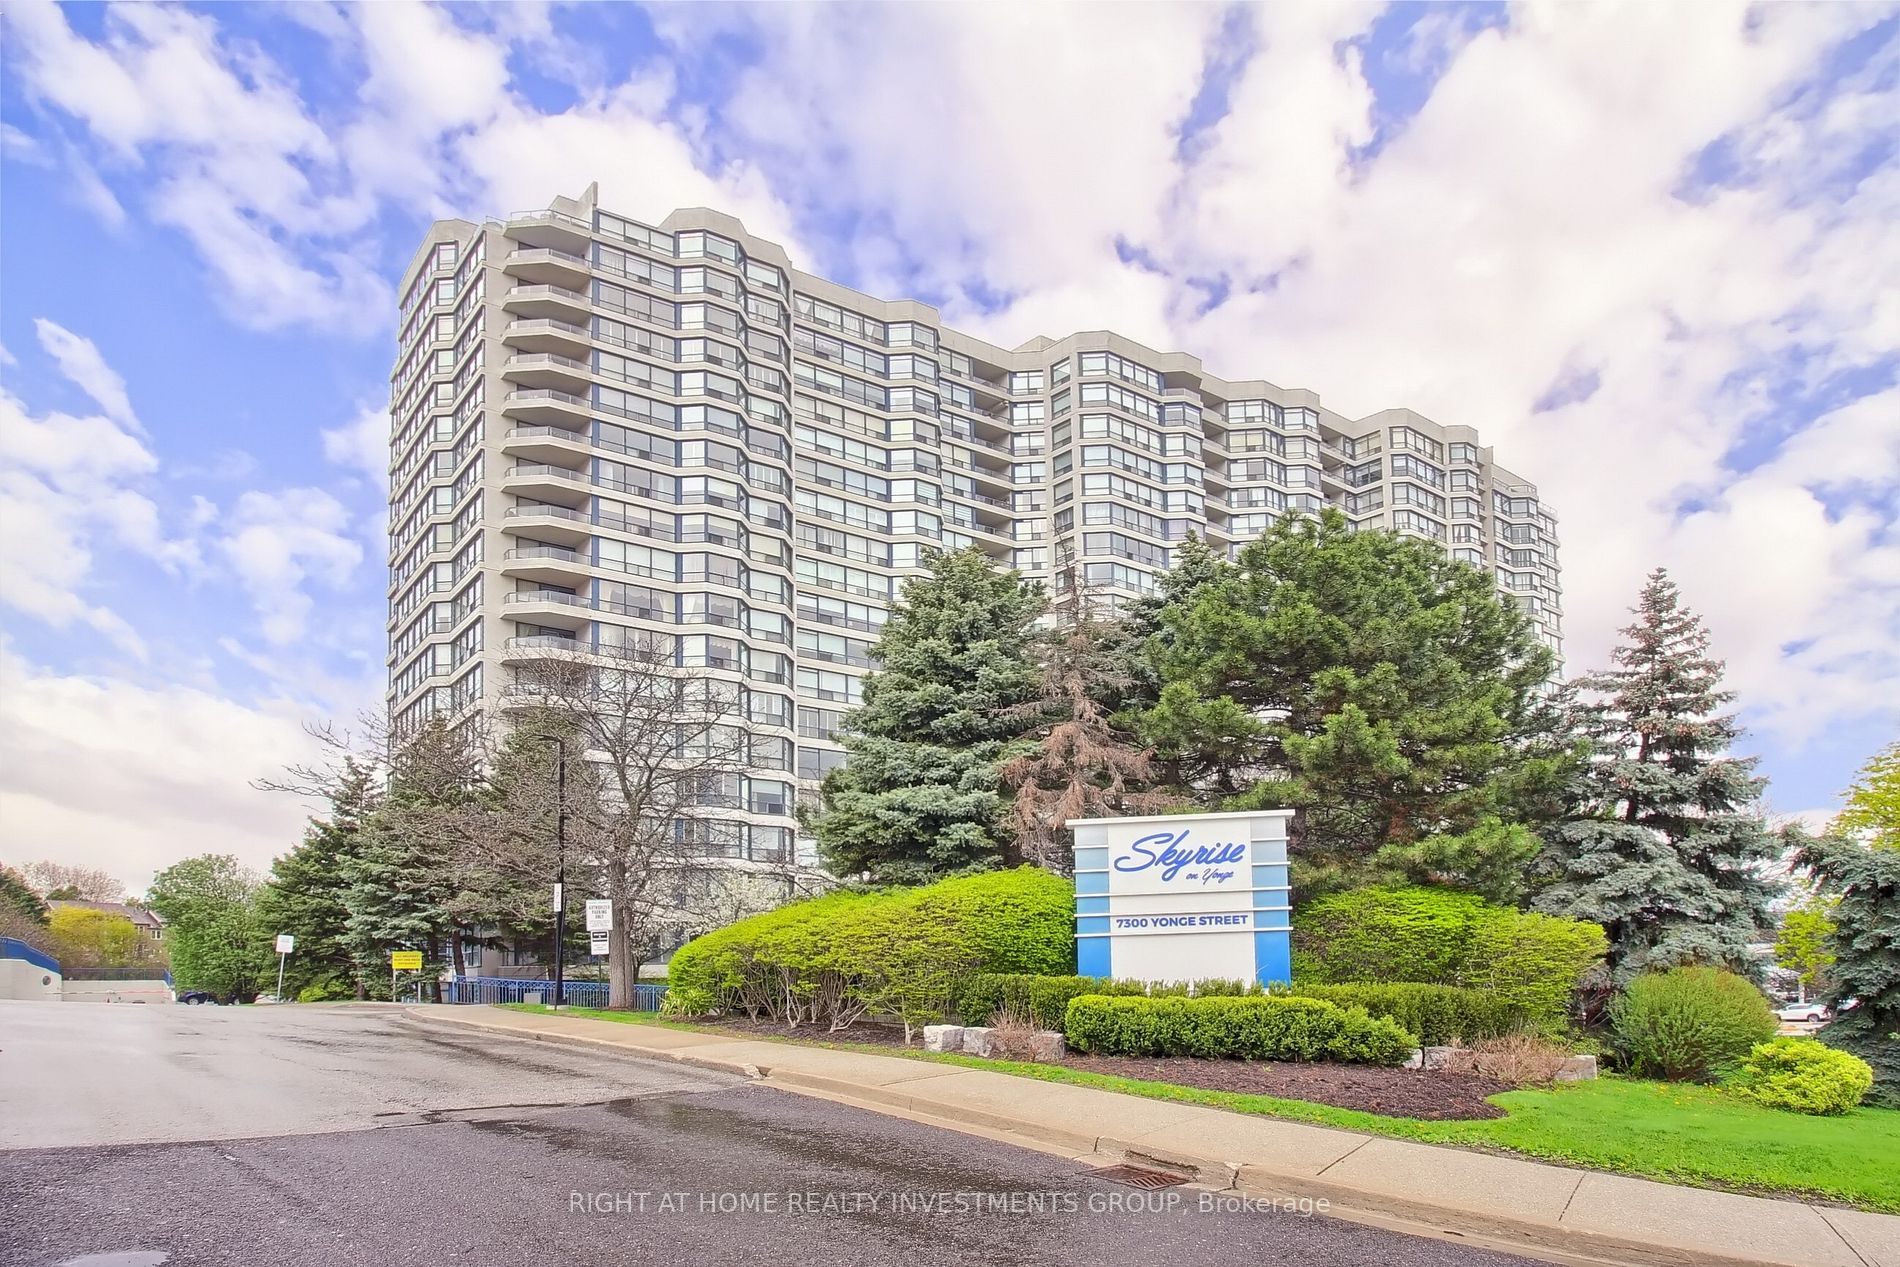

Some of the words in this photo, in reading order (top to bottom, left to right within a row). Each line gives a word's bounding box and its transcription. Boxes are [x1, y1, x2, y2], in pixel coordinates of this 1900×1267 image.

[1114, 829, 1245, 881] Skyrise
[1186, 872, 1198, 880] on
[1203, 868, 1233, 885] Yonge
[1116, 919, 1148, 928] 7300
[1151, 917, 1196, 927] YONGE
[1199, 915, 1248, 926] STREET
